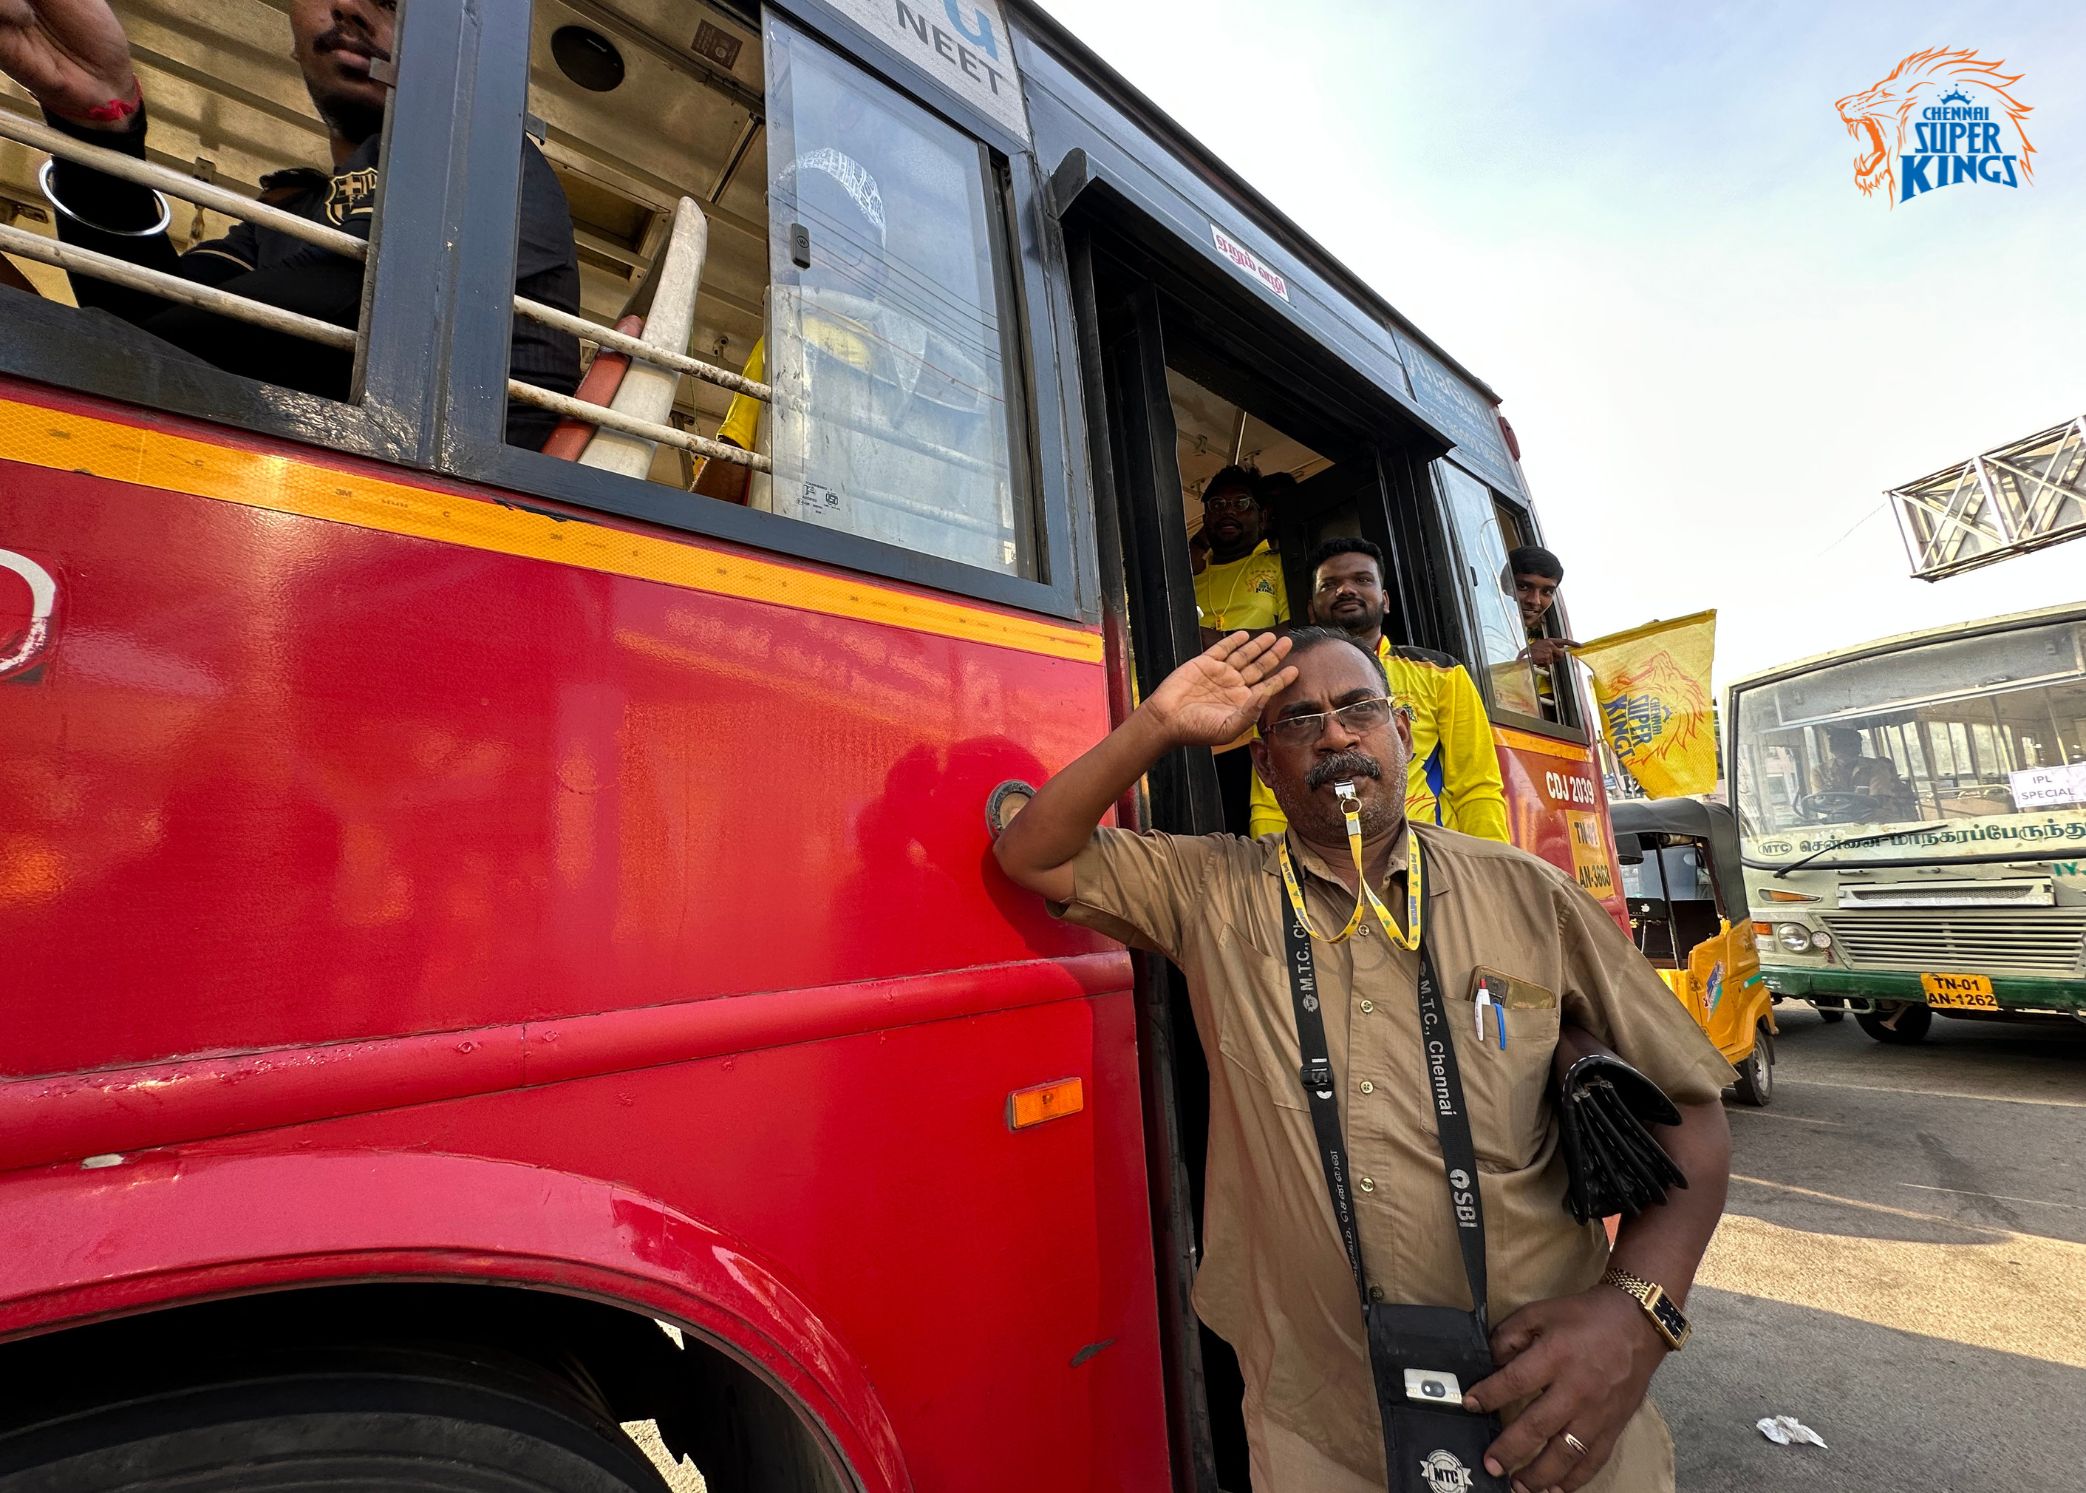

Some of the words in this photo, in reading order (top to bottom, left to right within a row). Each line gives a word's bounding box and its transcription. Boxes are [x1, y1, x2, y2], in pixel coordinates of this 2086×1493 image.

[895, 0, 1003, 96] NEET
[1601, 692, 1636, 759] KINGS
[1628, 694, 1653, 748] SUPER
[1650, 696, 1663, 736] CHENNAI
[1545, 770, 1570, 801] CDJ
[1569, 775, 1595, 805] 2039
[2021, 788, 2076, 800] SPECIAL
[2032, 775, 2053, 784] IPL
[1762, 843, 1789, 854] MTC
[1928, 992, 1997, 1007] AN-1262
[1933, 977, 1980, 991] TN-01
[1429, 1040, 1457, 1116] Chennai
[1453, 1190, 1478, 1228] SBI
[1434, 1467, 1460, 1484] MTC
